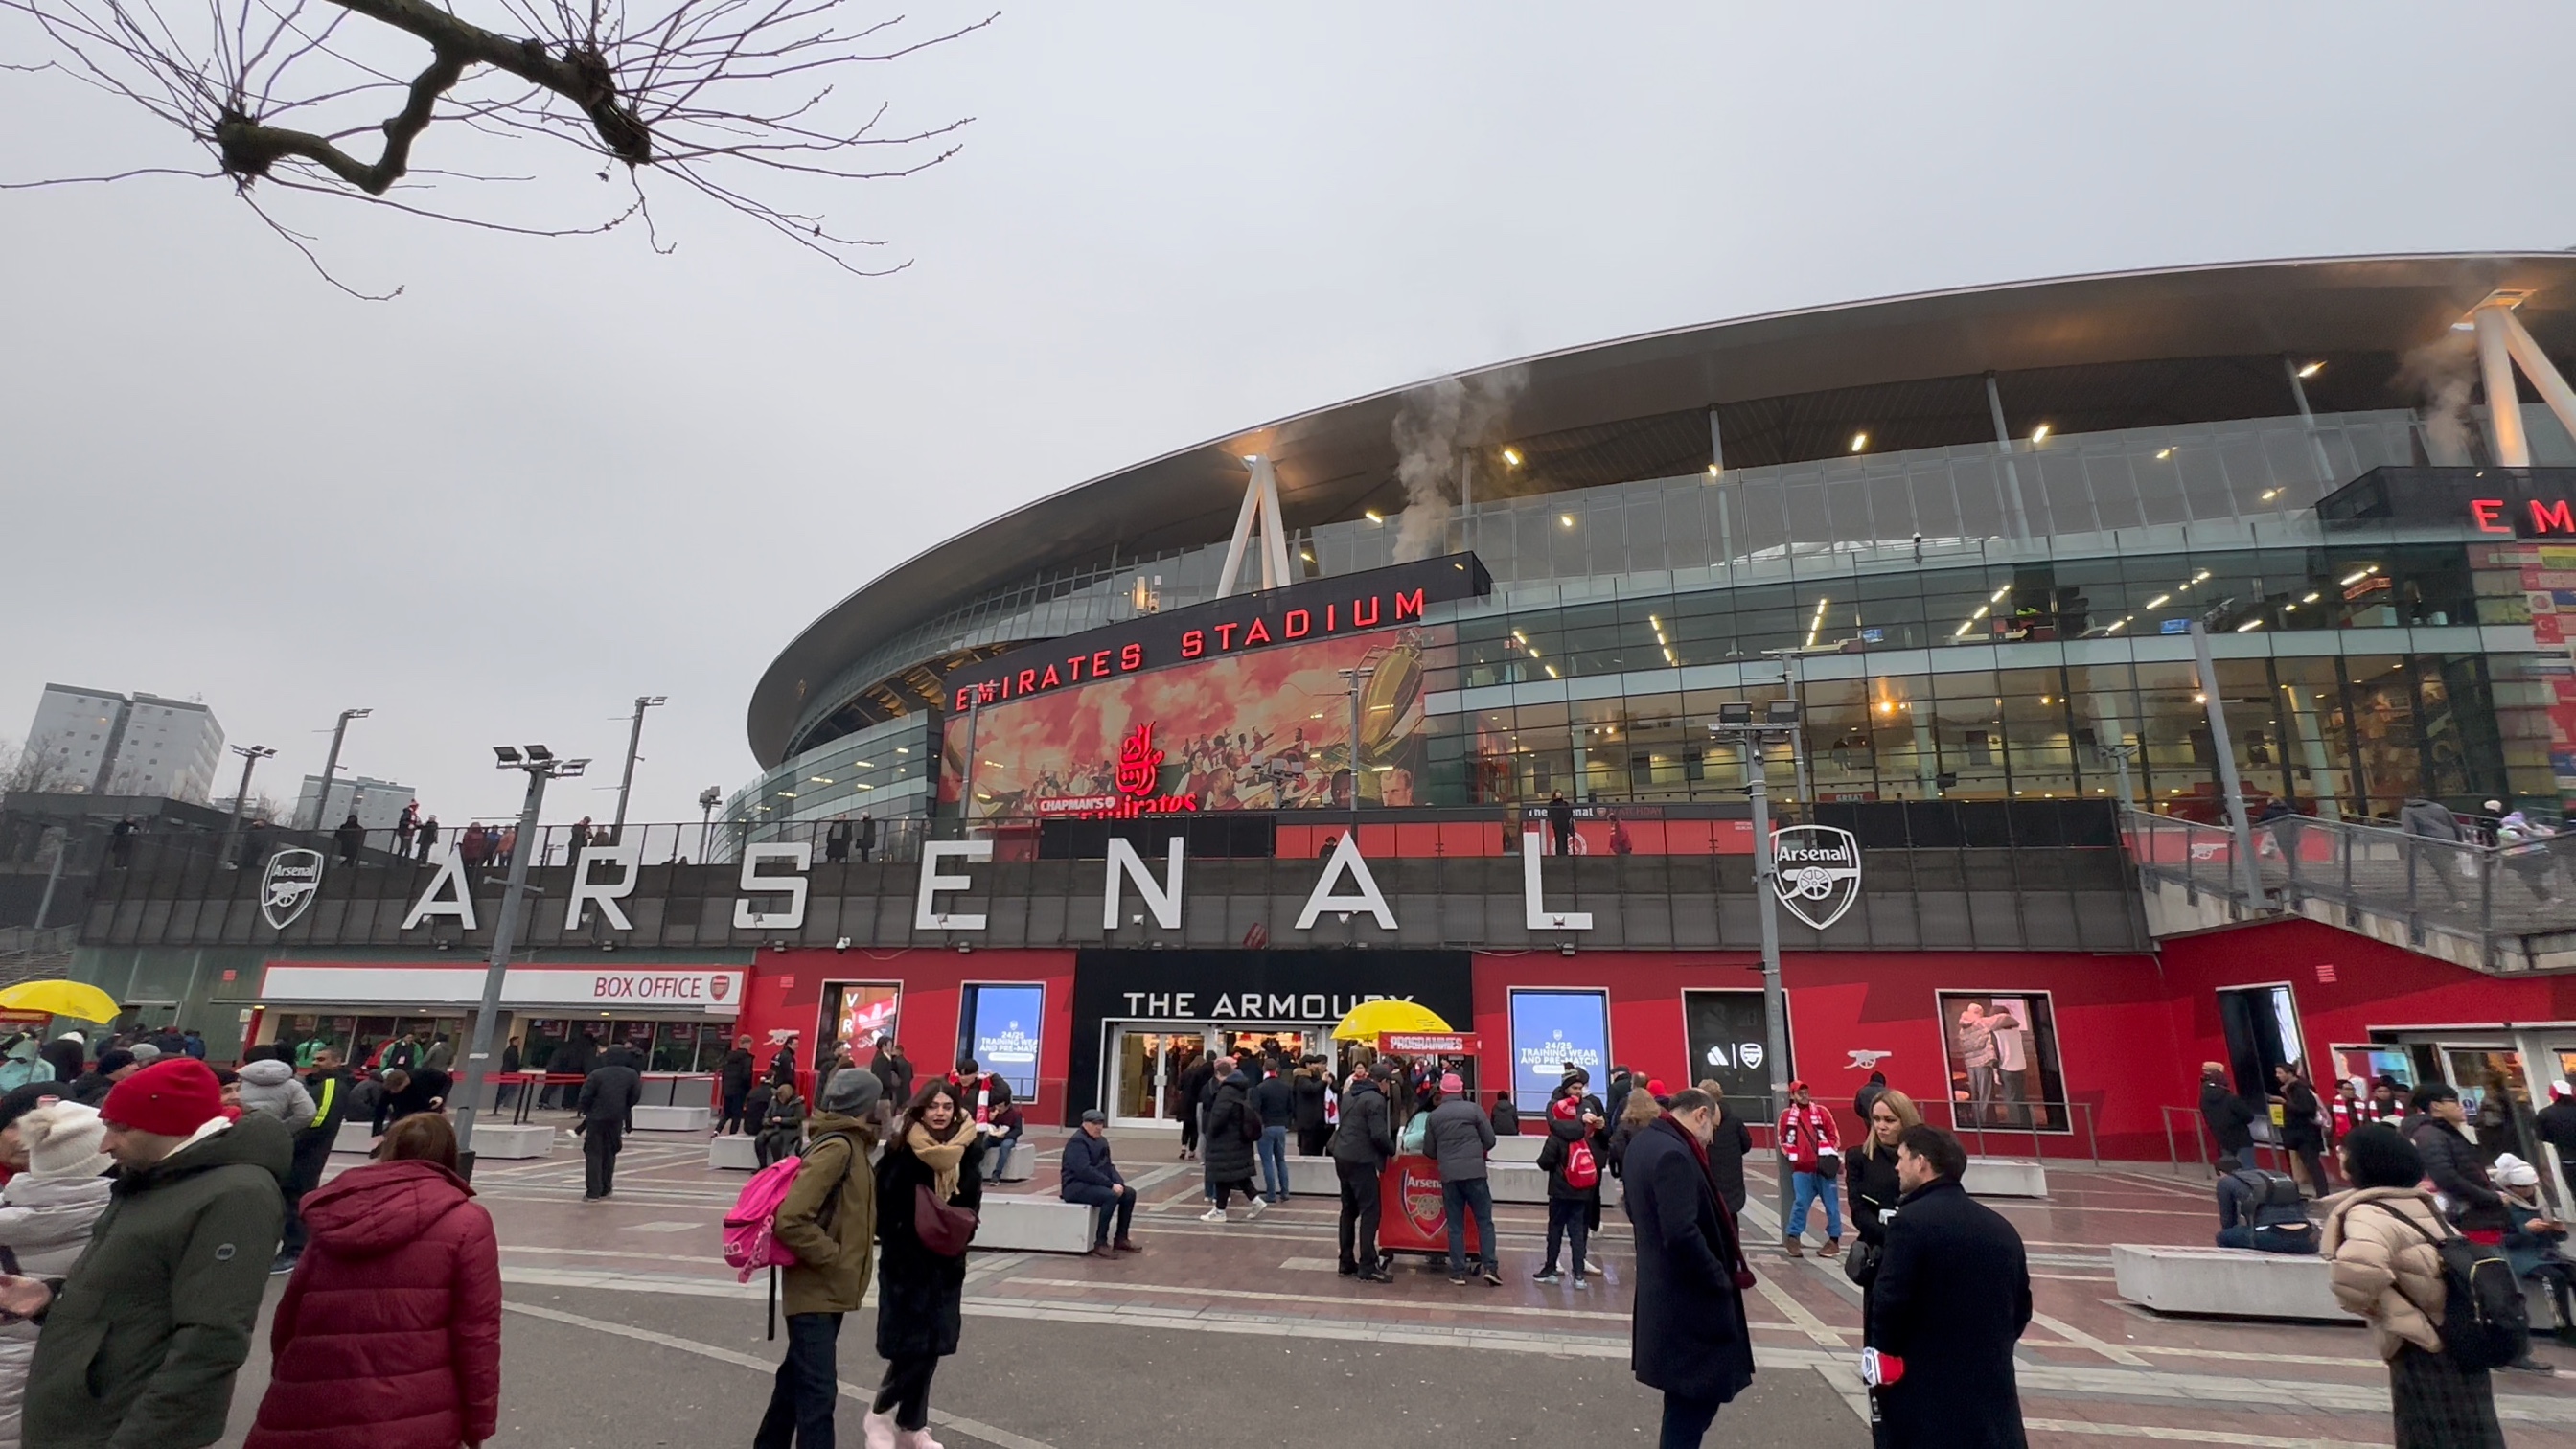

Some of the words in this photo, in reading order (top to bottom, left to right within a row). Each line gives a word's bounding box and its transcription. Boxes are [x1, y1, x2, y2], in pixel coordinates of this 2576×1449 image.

[954, 642, 1142, 712] EMIRATES
[1181, 587, 1425, 658] STADIUM
[1040, 796, 1105, 813] CHAPMAN'S
[1778, 845, 1848, 862] Arsenal
[273, 864, 315, 877] Arsenal
[400, 830, 1593, 932] ARSENAL
[594, 977, 634, 998] BOX
[638, 977, 703, 999] OFFICE
[1123, 992, 1196, 1017] THE
[1211, 992, 1414, 1020] ARMOU
[981, 1038, 1019, 1046] TRAINING
[1001, 1031, 1025, 1040] 24/25
[979, 1045, 1000, 1053] AND
[1390, 1036, 1463, 1051] PROGRAMMES
[1545, 1042, 1573, 1050] 24/25
[1521, 1048, 1567, 1058] TRAINING
[1569, 1049, 1597, 1058] WEAR
[1544, 1056, 1598, 1066] PRE-MATCH
[1408, 1175, 1443, 1189] Arsen
